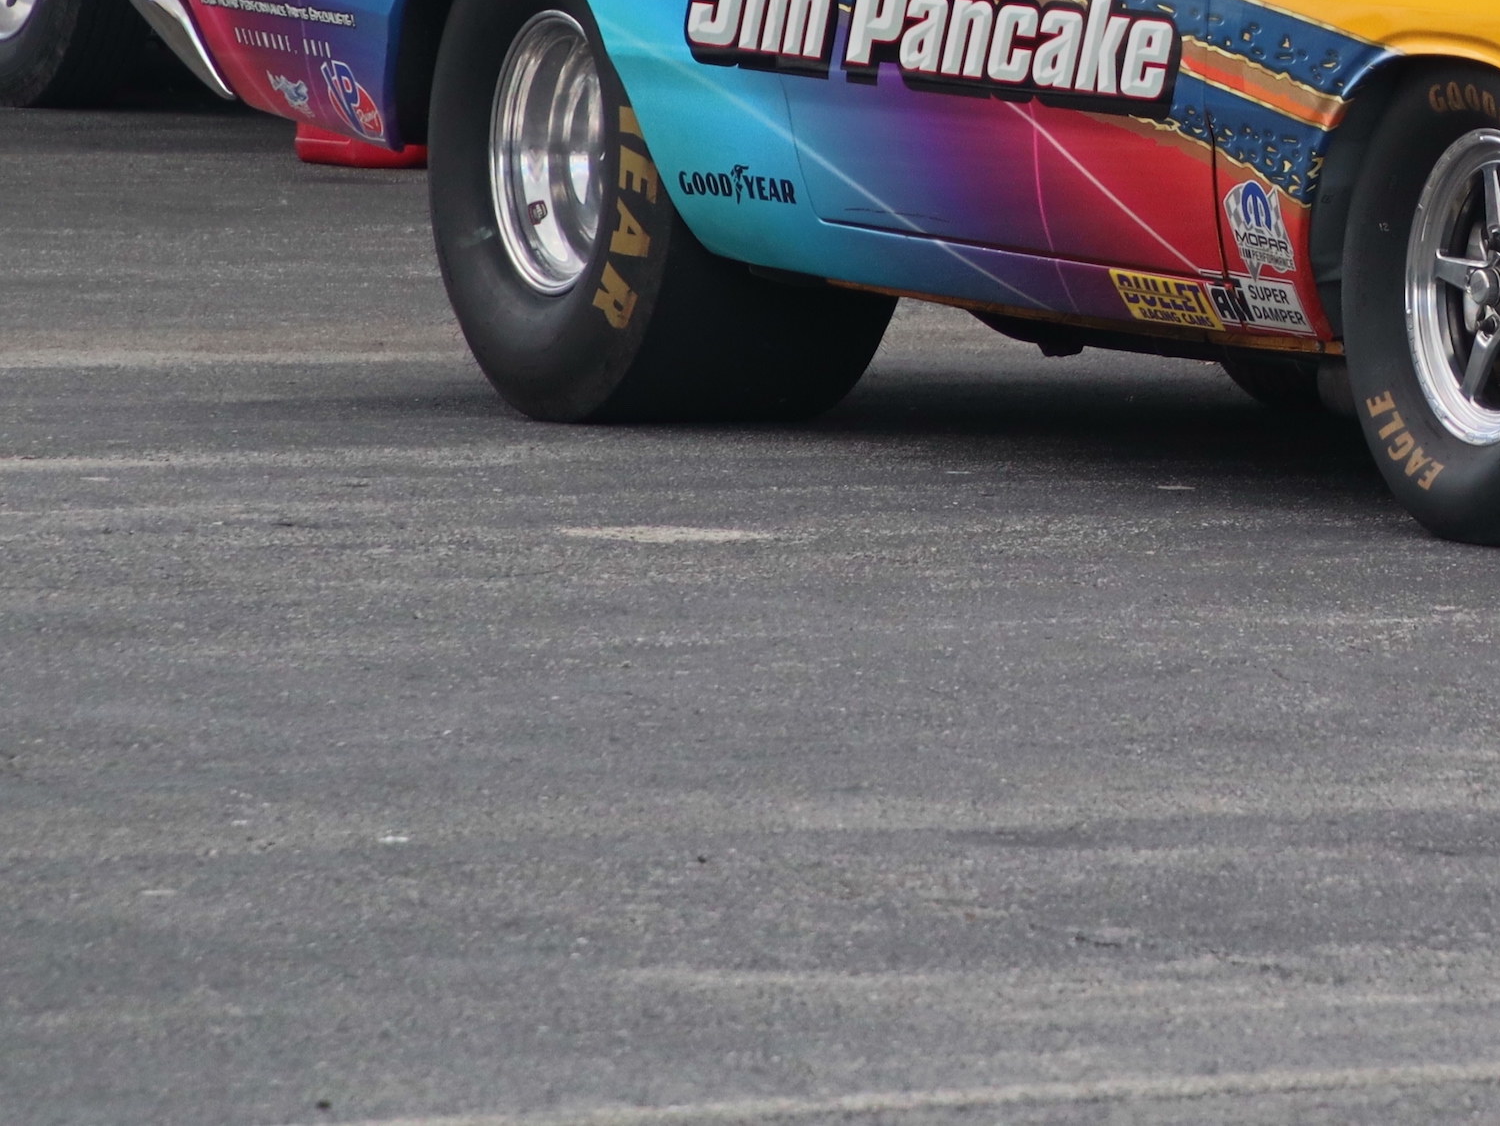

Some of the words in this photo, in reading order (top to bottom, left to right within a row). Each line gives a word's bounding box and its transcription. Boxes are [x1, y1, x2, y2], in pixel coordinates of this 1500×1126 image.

[1234, 229, 1291, 255] MOPAR
[1117, 273, 1208, 315] BULLET
[1247, 284, 1291, 305] SUPER
[1139, 306, 1182, 324] RACING
[1182, 311, 1216, 328] CAMS
[1251, 304, 1308, 327] DAMPER
[1366, 390, 1445, 491] EAGLE
